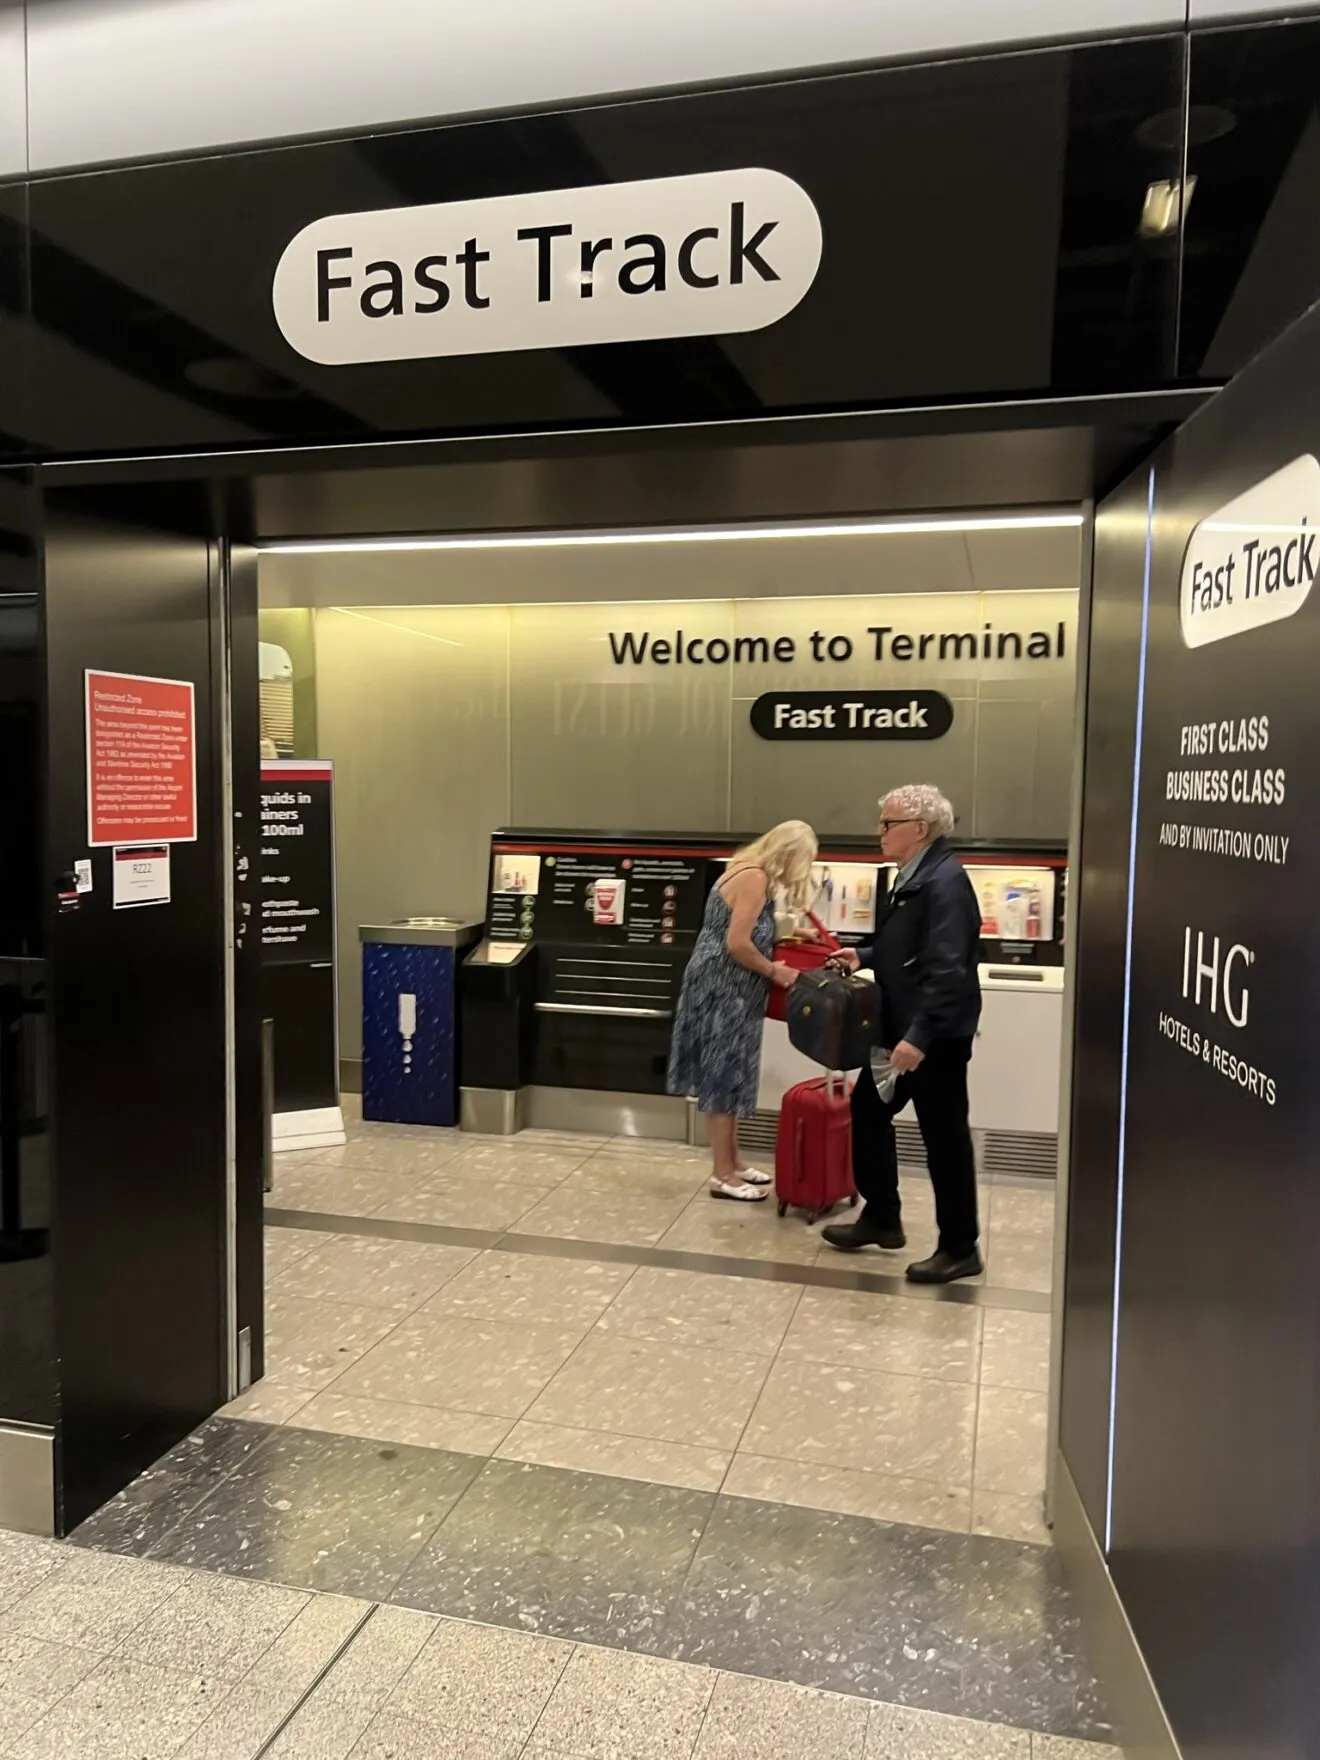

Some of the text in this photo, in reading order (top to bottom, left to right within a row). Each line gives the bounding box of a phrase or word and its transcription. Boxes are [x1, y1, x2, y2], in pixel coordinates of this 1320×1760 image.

[316, 201, 782, 323] Fast Track
[1191, 515, 1317, 616] Fast Track
[609, 621, 1066, 666] Welcome to Terminal
[773, 700, 929, 730] Fast Track
[1181, 715, 1269, 756] FIRST CLASS
[297, 792, 312, 804] in
[1166, 768, 1285, 806] BUSINESS CLASS
[261, 824, 304, 836] 100ml
[1159, 822, 1290, 865] AND BY INVITATION ONLY
[1182, 926, 1250, 1028] IHG
[1159, 1011, 1276, 1106] HOTELS & RESORTS
